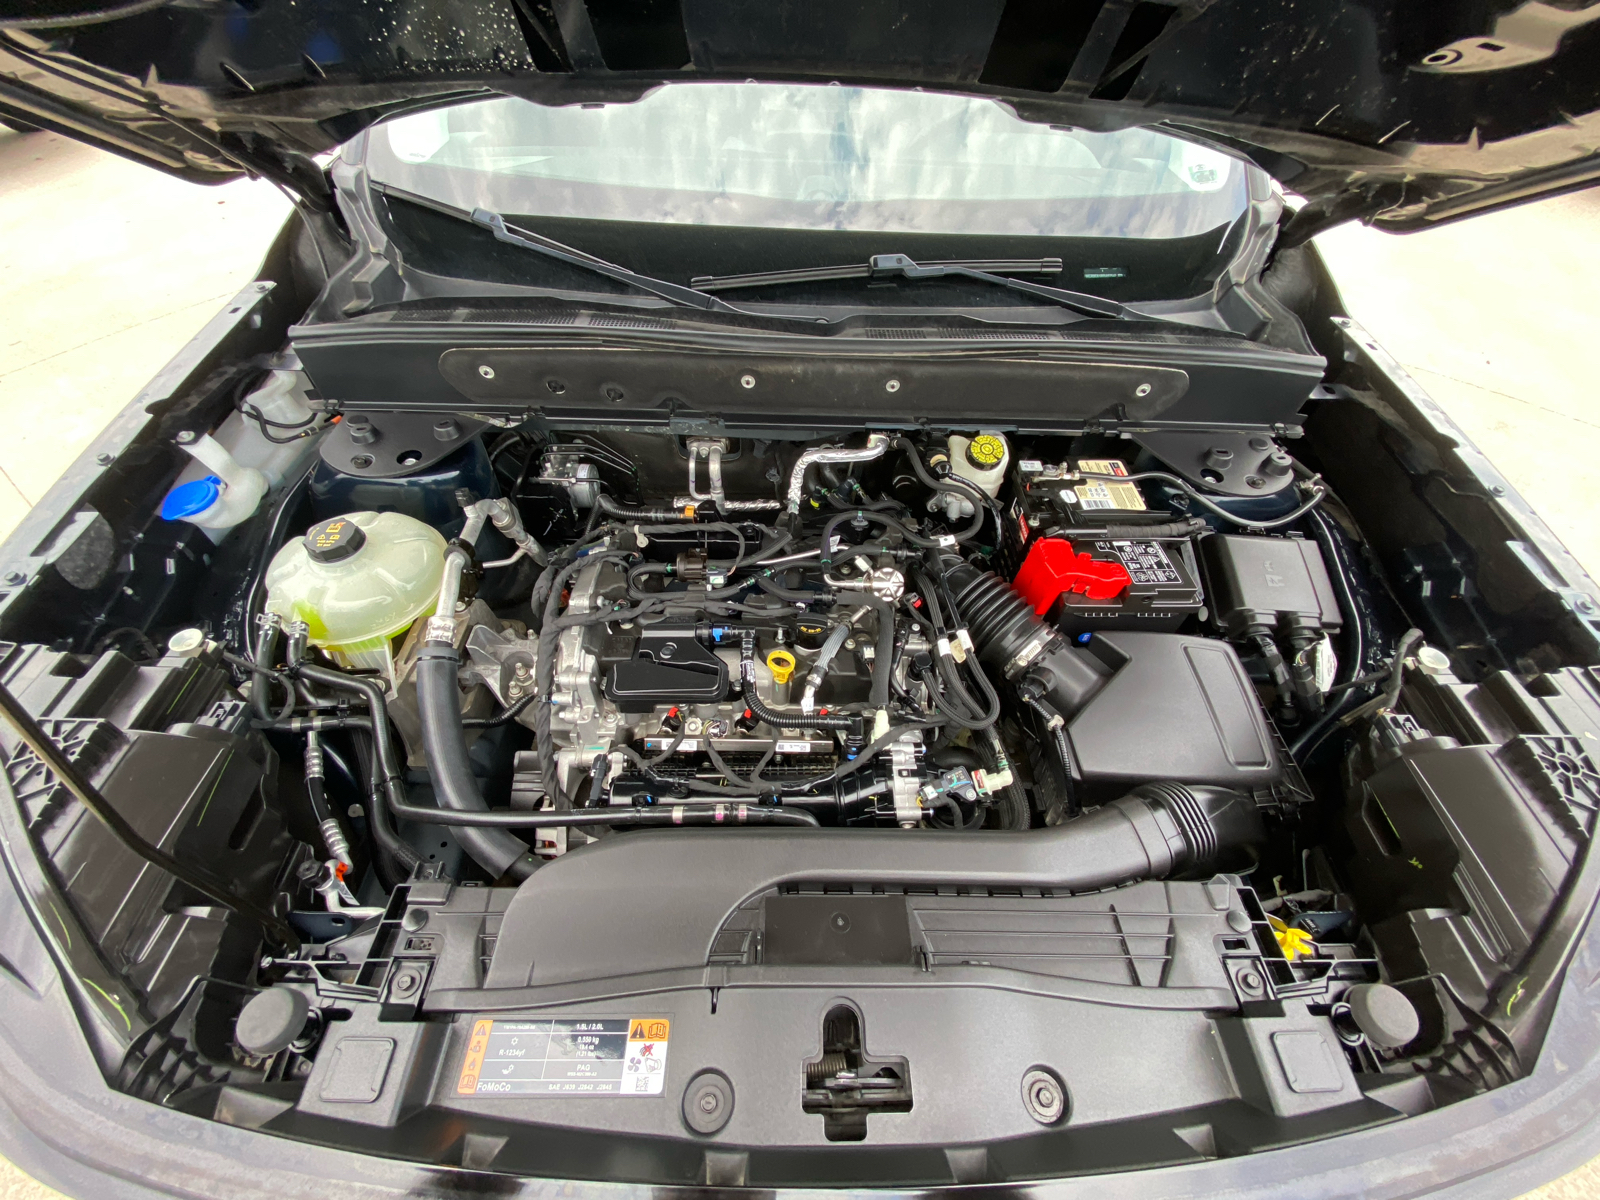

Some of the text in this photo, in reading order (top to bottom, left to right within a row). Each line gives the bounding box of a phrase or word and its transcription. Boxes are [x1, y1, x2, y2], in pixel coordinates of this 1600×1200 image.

[498, 1048, 526, 1058] R-1234yf
[576, 1064, 591, 1072] PAG
[476, 1082, 511, 1092] FoMoCo
[548, 1083, 560, 1091] SAE
